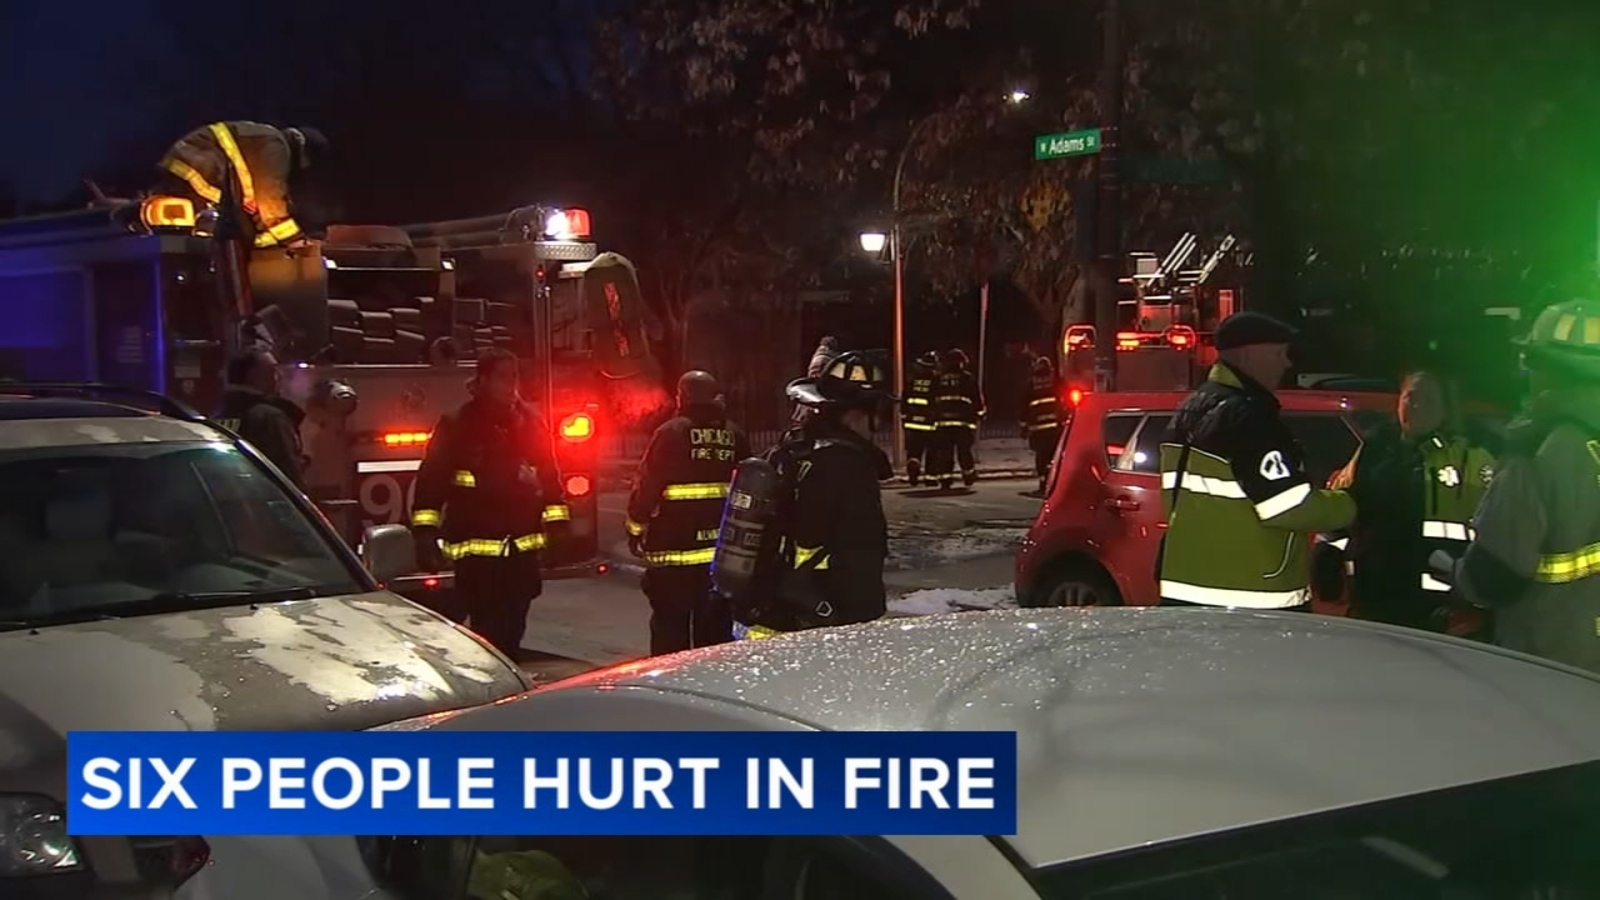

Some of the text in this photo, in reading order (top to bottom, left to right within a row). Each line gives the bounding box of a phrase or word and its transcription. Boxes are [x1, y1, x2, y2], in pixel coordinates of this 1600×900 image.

[1049, 138, 1084, 155] Adams
[690, 428, 736, 446] CHICAGO
[691, 448, 712, 460] FIRE
